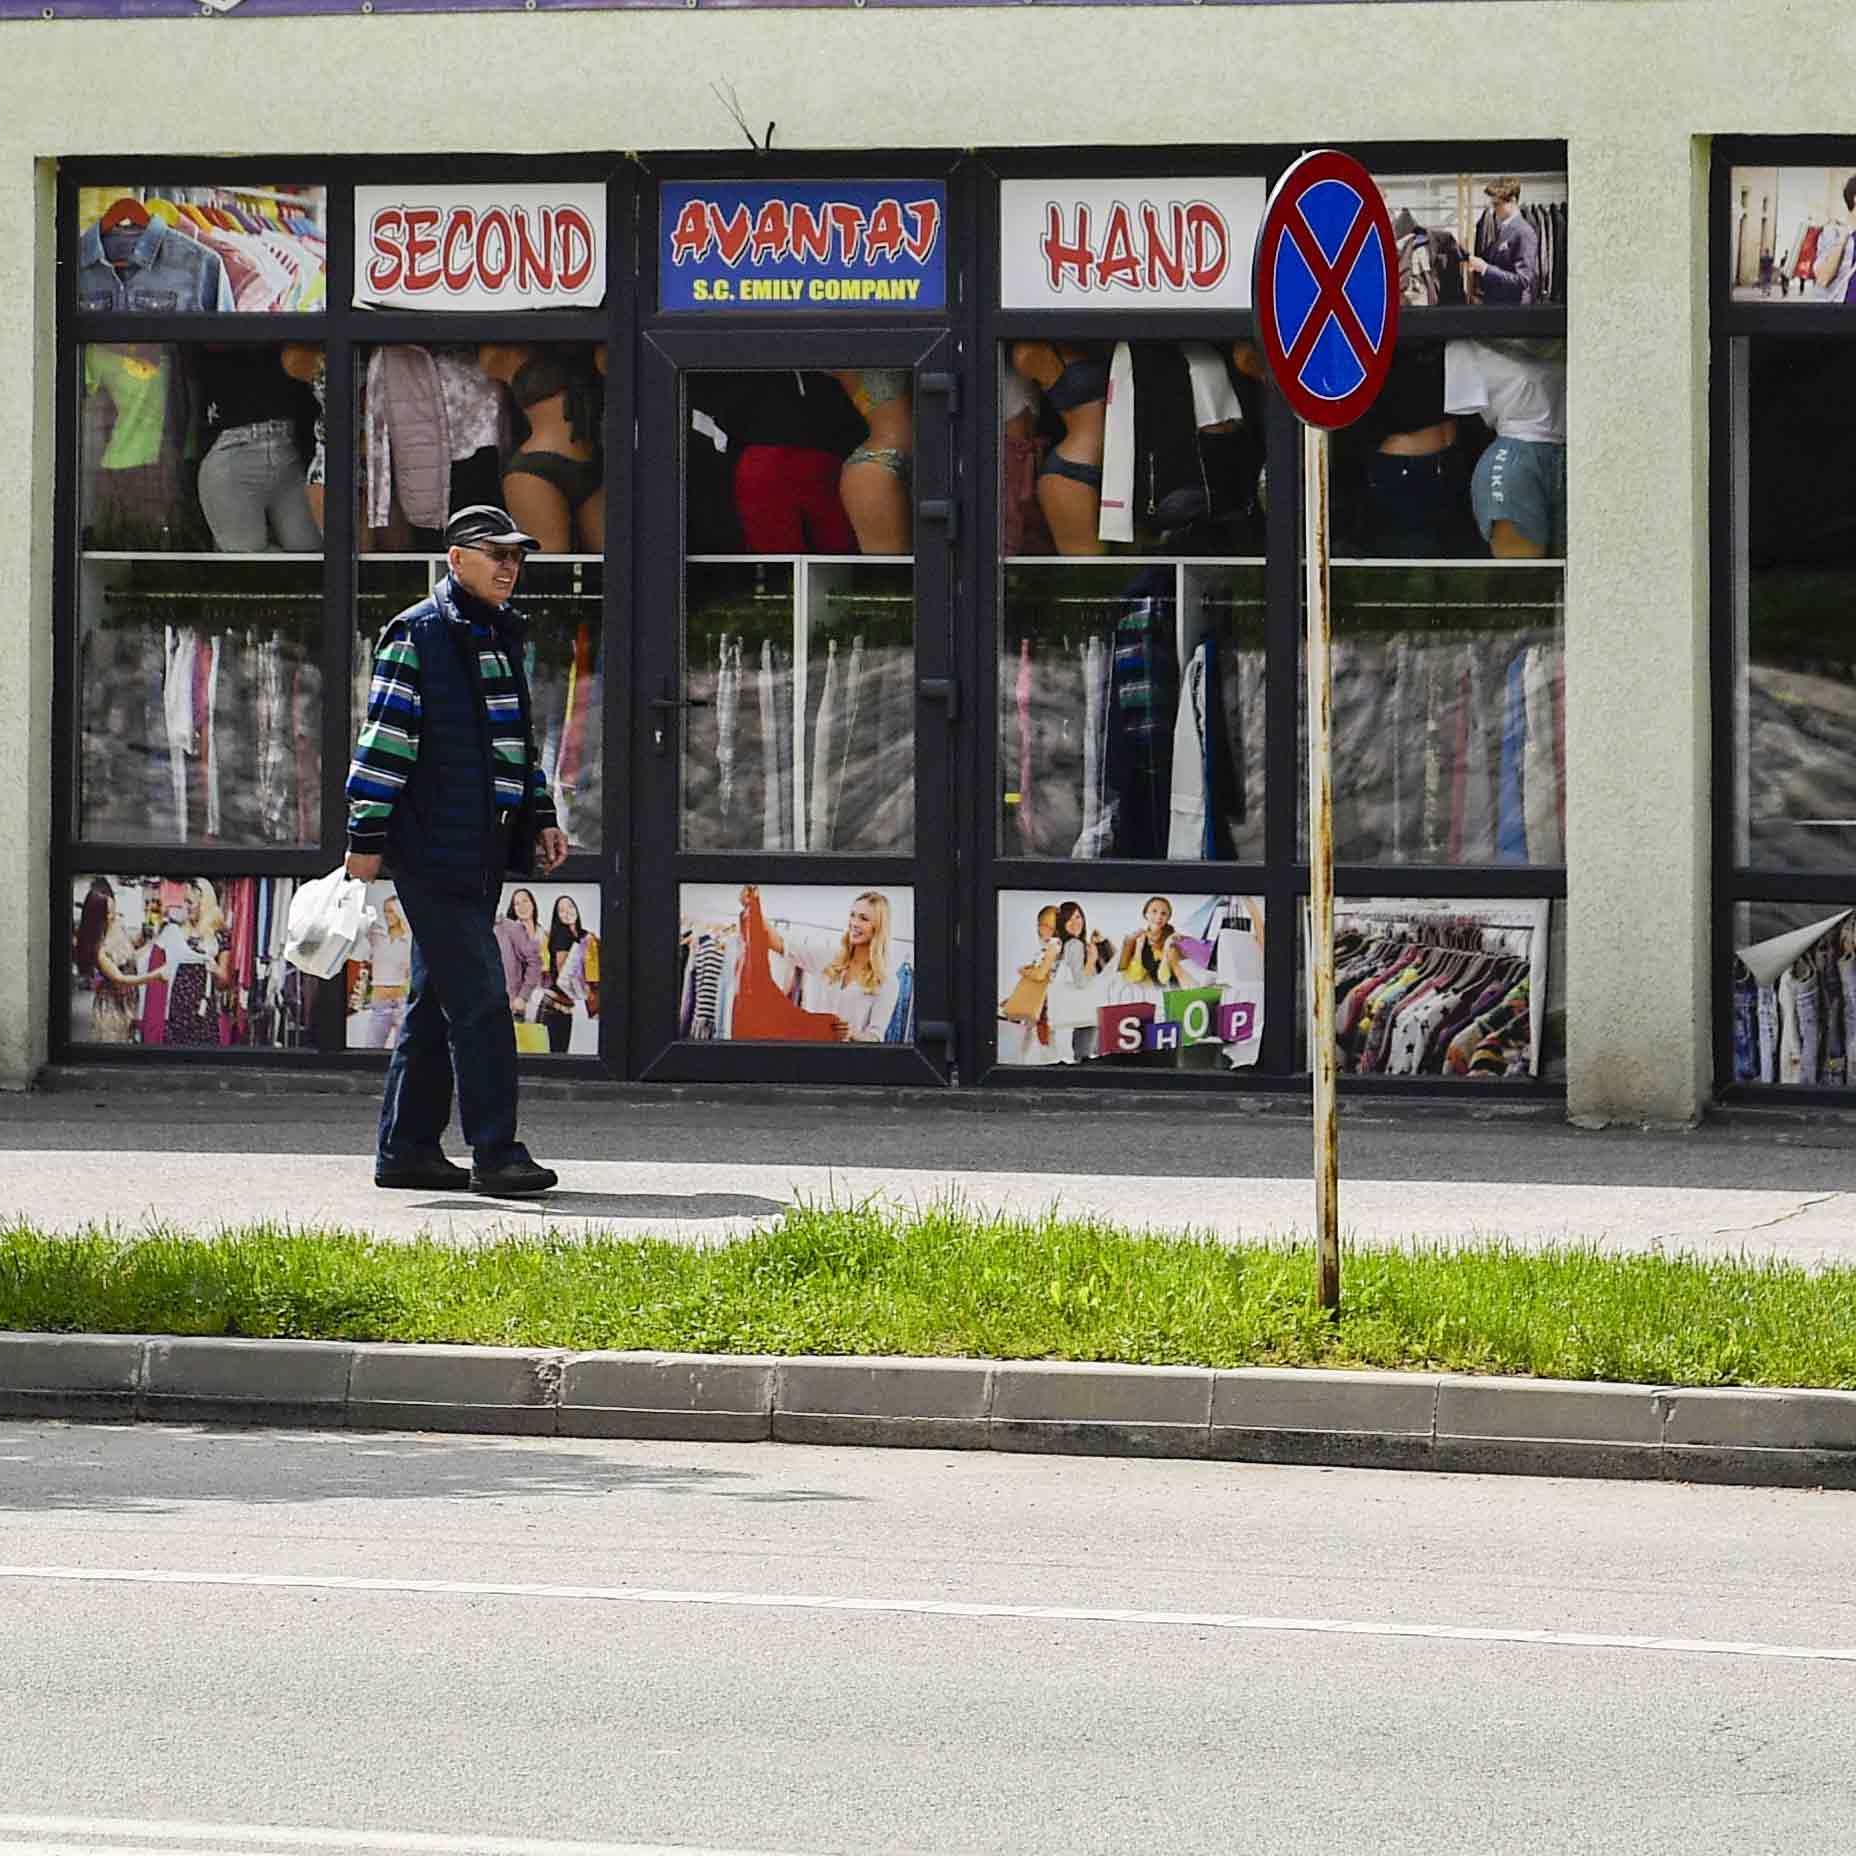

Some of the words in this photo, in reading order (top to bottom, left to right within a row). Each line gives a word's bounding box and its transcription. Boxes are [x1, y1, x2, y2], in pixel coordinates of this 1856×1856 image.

[368, 206, 595, 293] SECOND
[671, 199, 940, 268] AVANTAJ
[1042, 202, 1229, 291] HAND
[693, 279, 735, 301] S.C.
[740, 279, 804, 301] EMILY
[808, 279, 920, 301] COMPANY
[1118, 1000, 1248, 1050] SHOP
